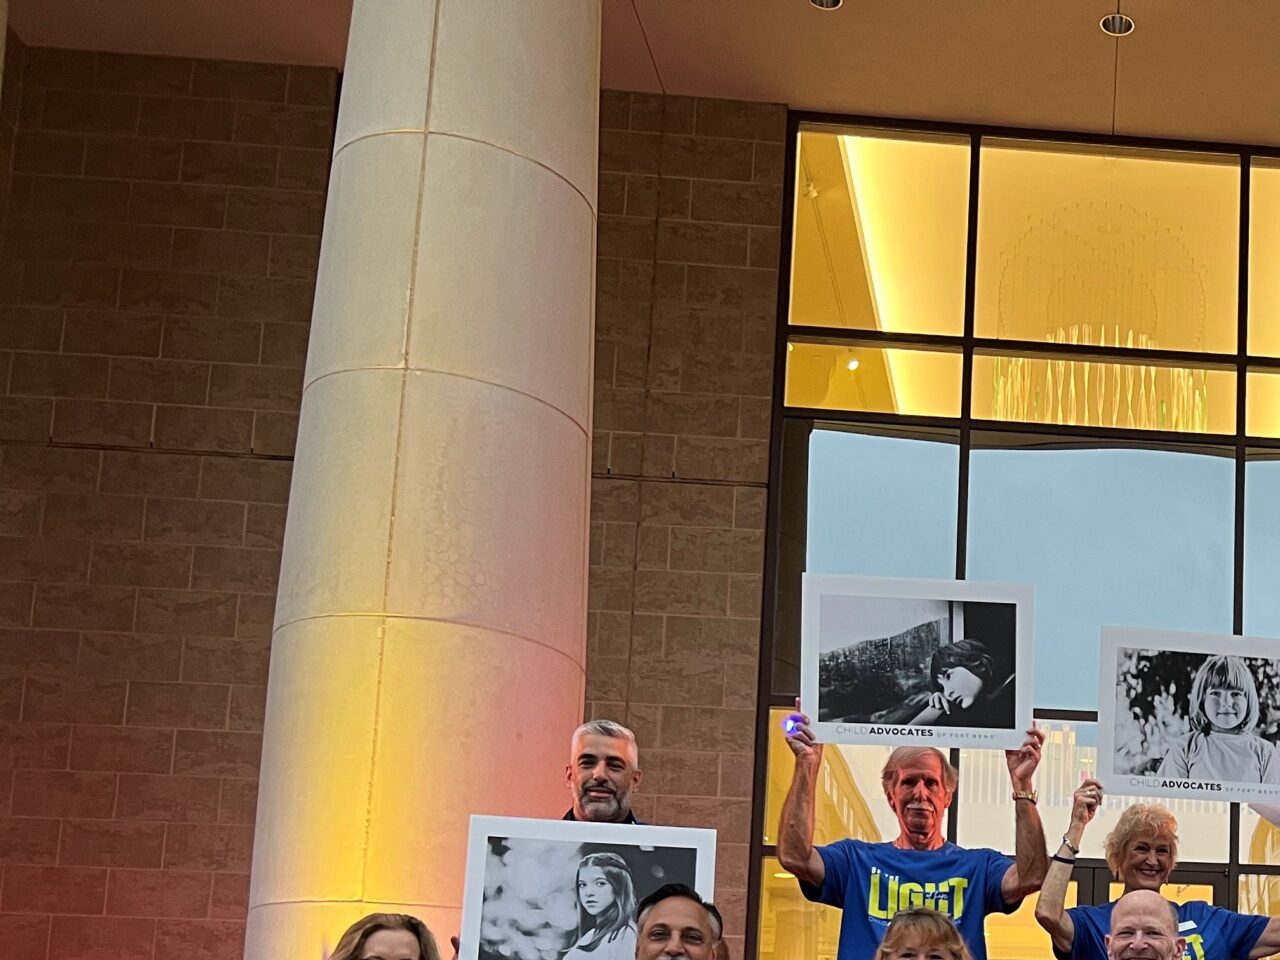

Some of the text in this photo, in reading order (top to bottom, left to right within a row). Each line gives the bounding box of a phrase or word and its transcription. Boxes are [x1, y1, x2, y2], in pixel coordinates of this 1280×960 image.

[869, 727, 933, 737] ADVOCATES
[1161, 780, 1222, 791] ADVOCATES
[868, 873, 969, 920] LIGHT
